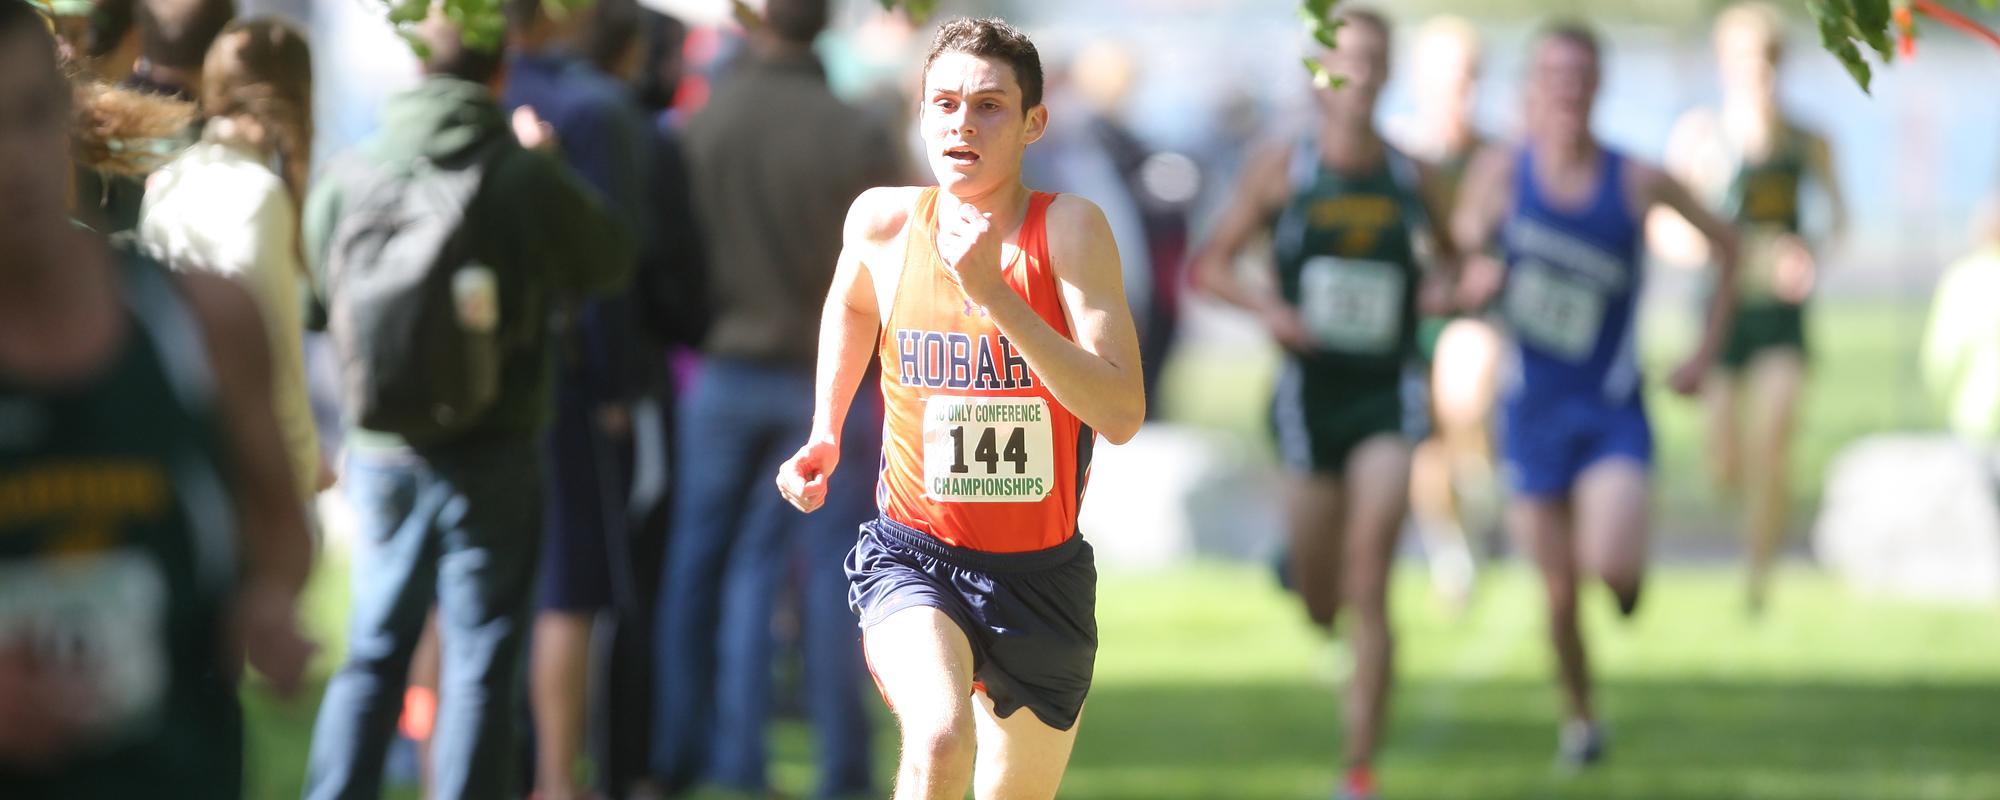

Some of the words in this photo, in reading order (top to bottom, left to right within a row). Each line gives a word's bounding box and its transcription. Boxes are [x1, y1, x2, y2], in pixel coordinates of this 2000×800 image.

[897, 328, 1043, 390] HOBAR
[948, 404, 973, 422] ONLY
[975, 404, 1041, 422] CONFERENCE
[949, 425, 1028, 474] 144
[934, 477, 1044, 496] CHAMPIONSHIPS
